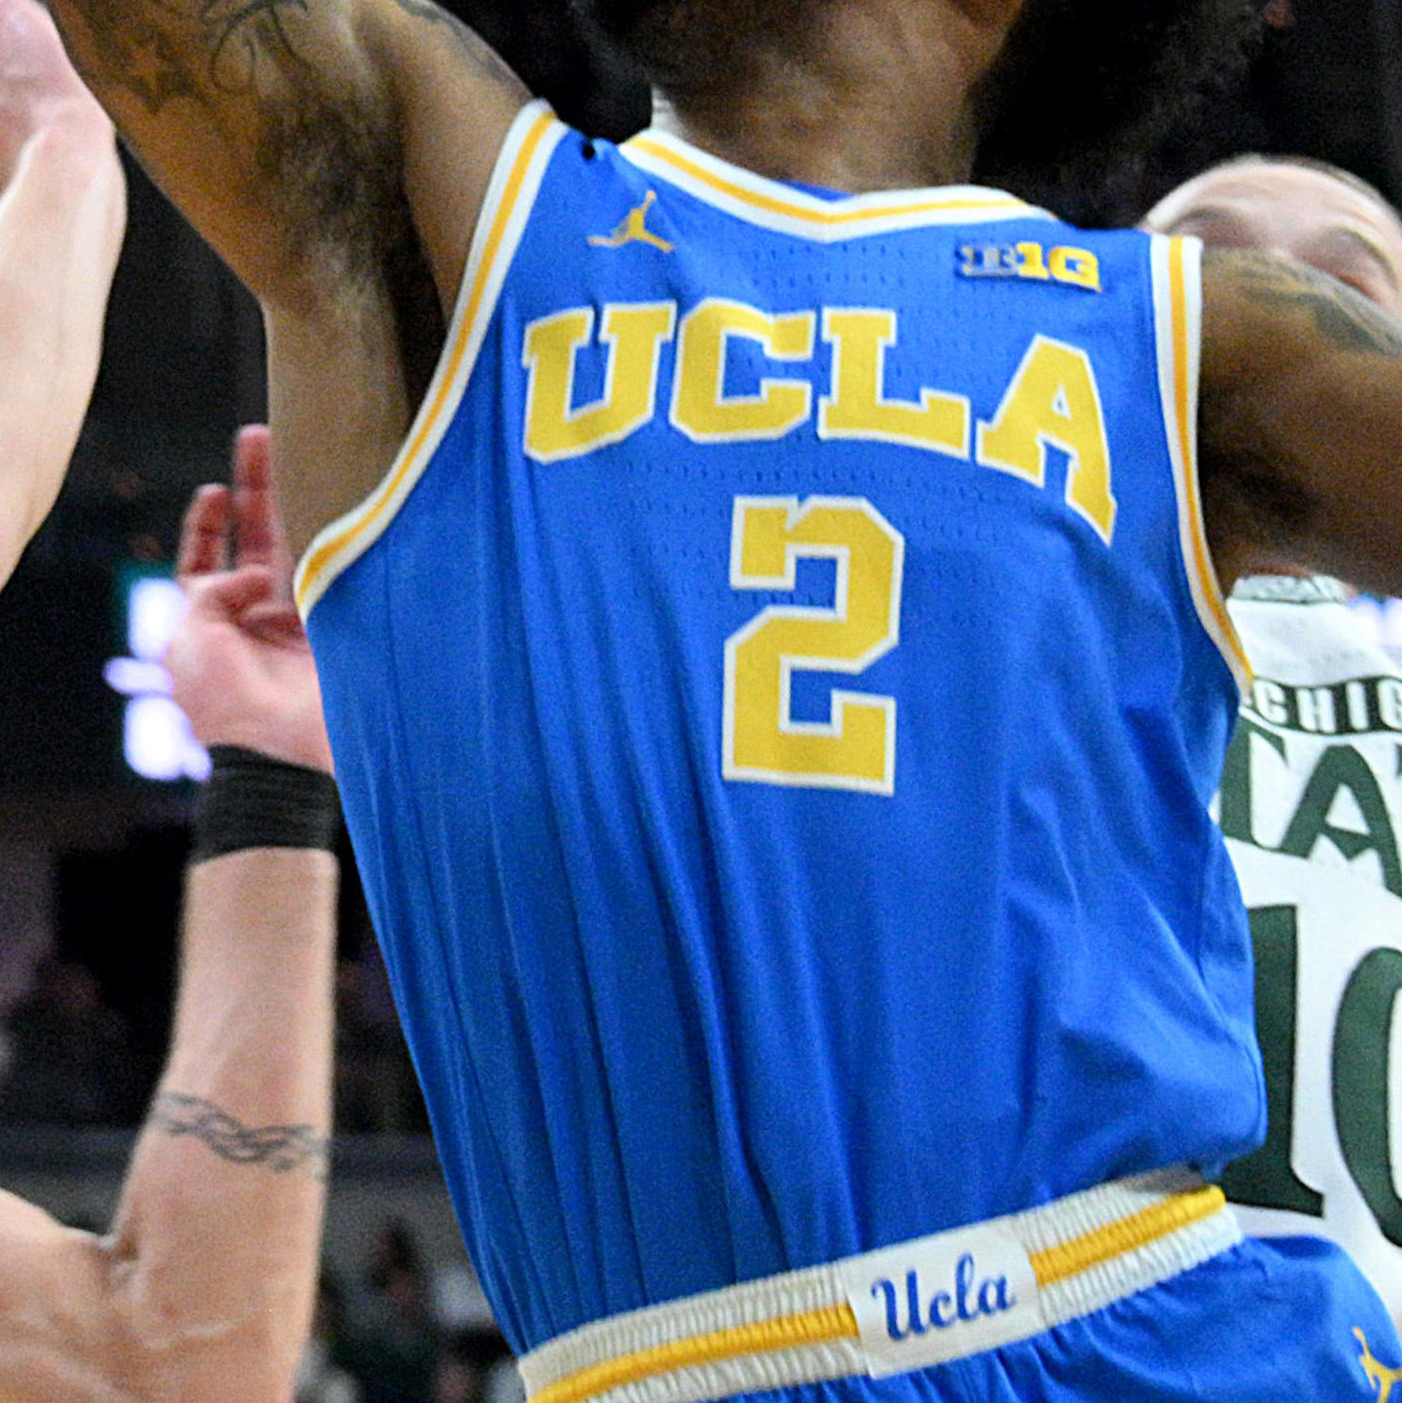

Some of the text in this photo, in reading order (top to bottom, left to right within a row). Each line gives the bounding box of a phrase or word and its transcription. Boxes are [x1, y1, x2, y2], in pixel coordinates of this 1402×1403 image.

[522, 297, 1117, 548] UCLA
[721, 494, 905, 796] 2
[870, 1250, 1017, 1342] Ucla
